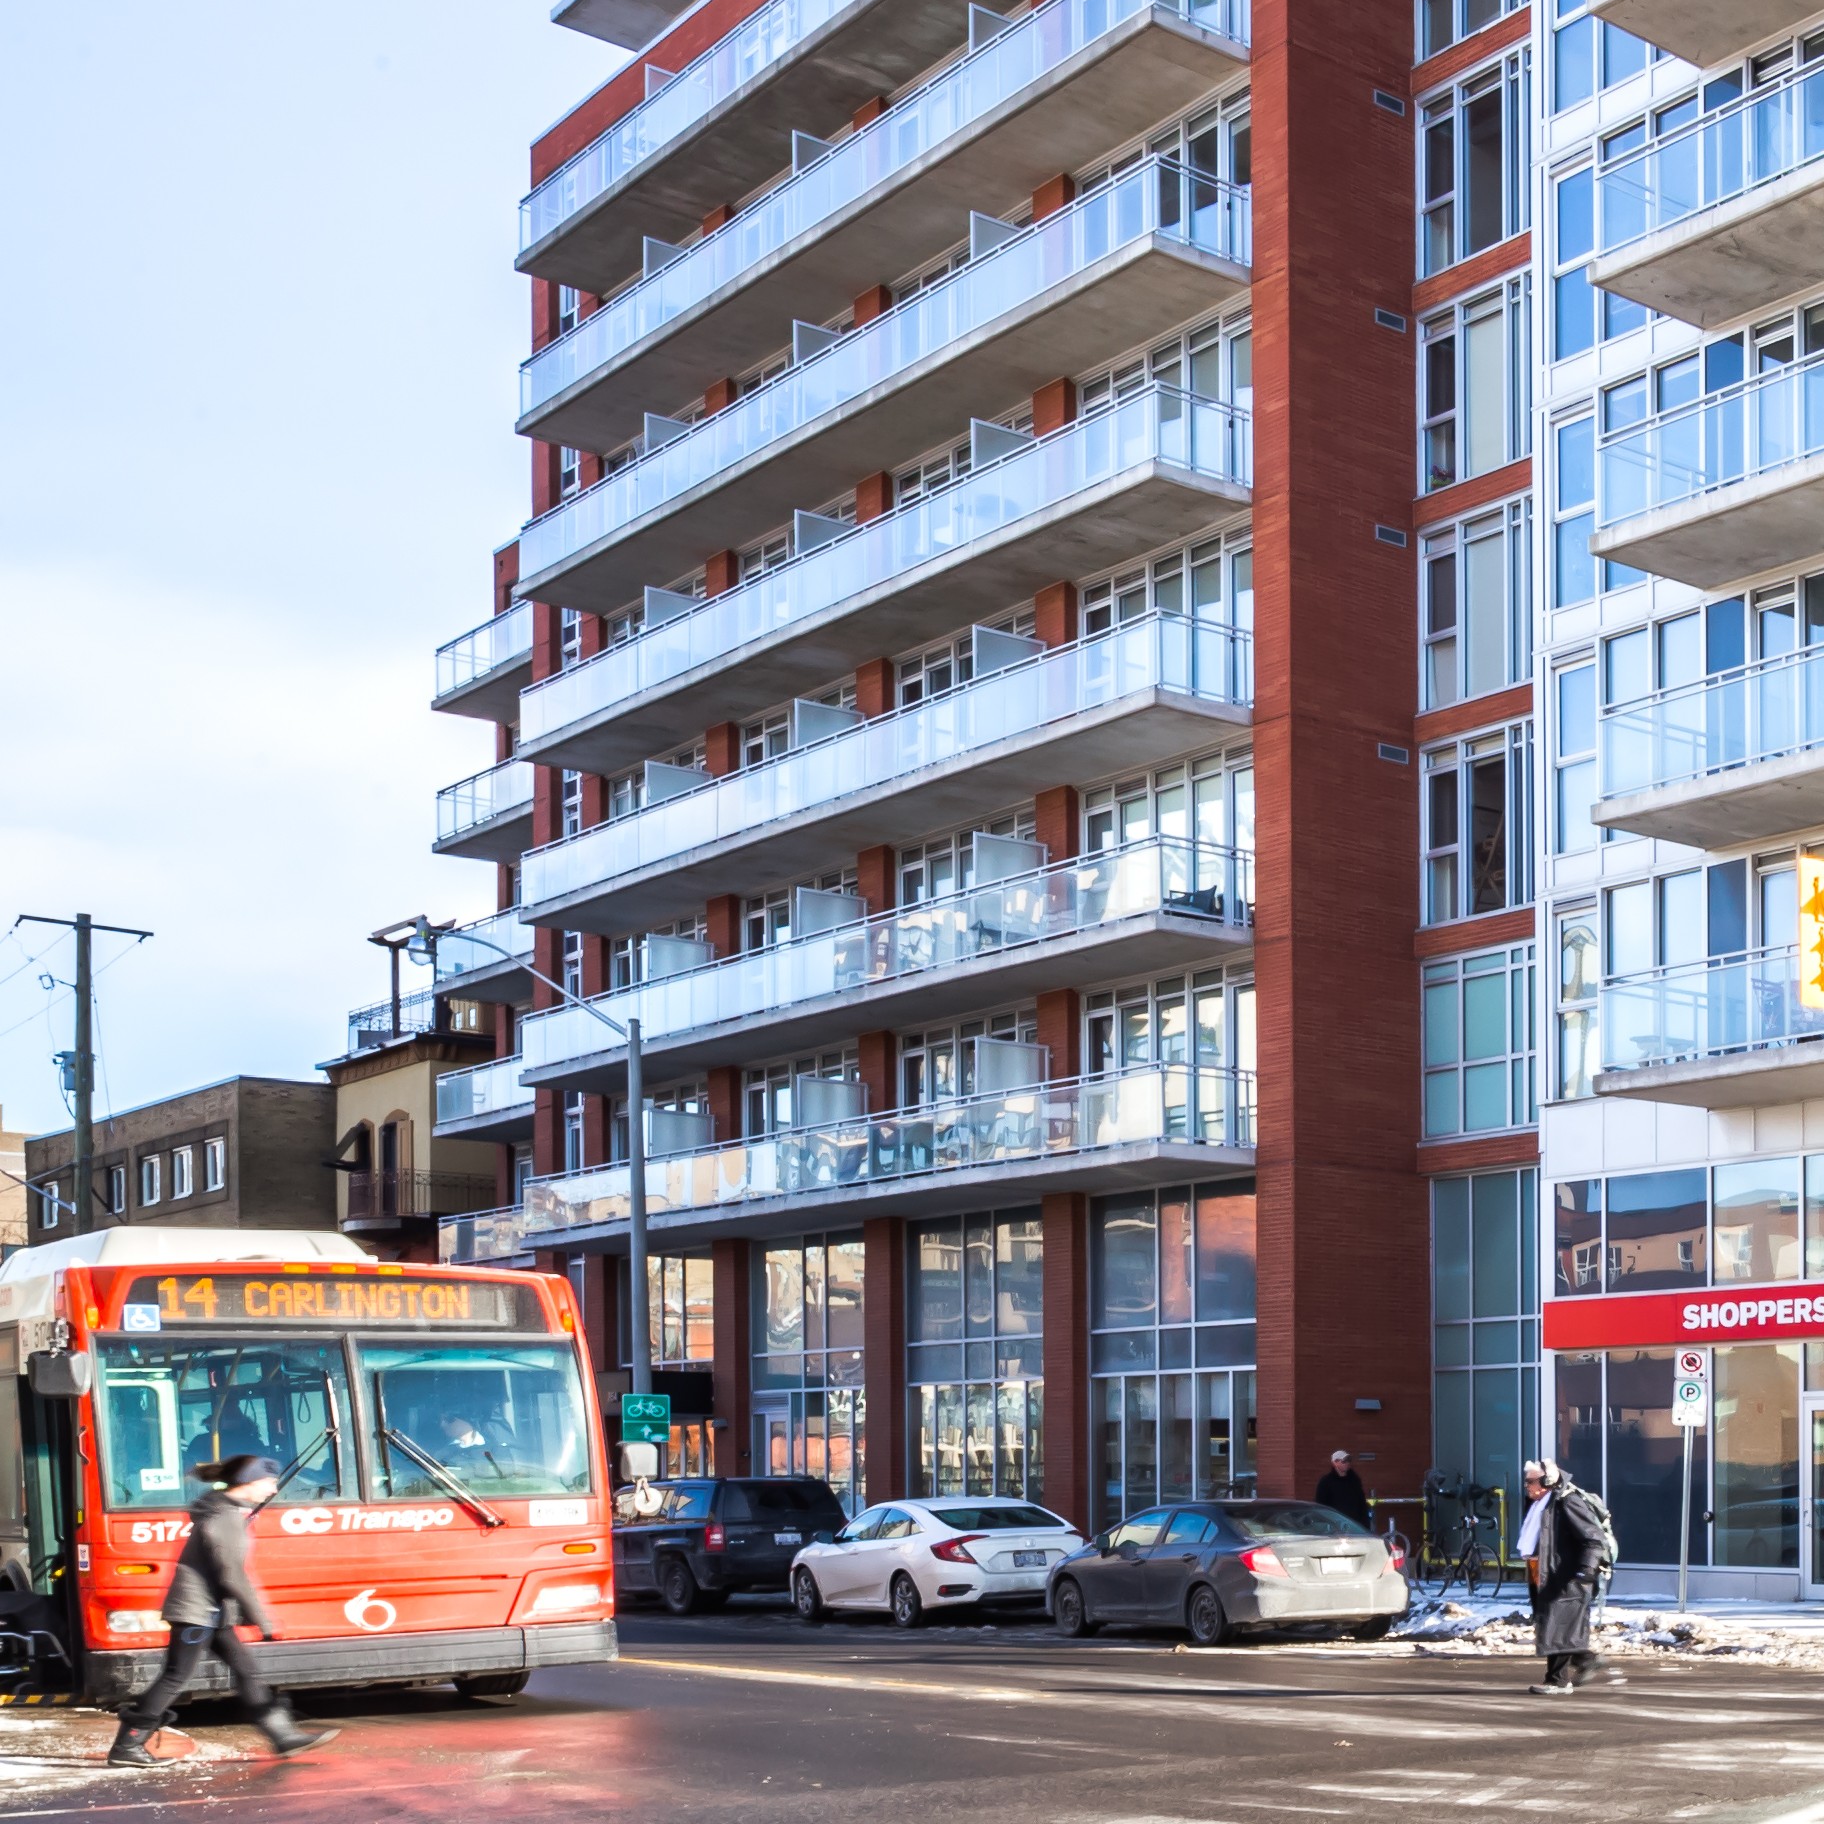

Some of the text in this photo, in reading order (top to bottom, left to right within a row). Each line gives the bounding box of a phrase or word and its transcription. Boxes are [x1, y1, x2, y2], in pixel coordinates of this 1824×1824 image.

[157, 1277, 470, 1319] 14 CARLINGTON
[337, 1507, 454, 1532] Transpo
